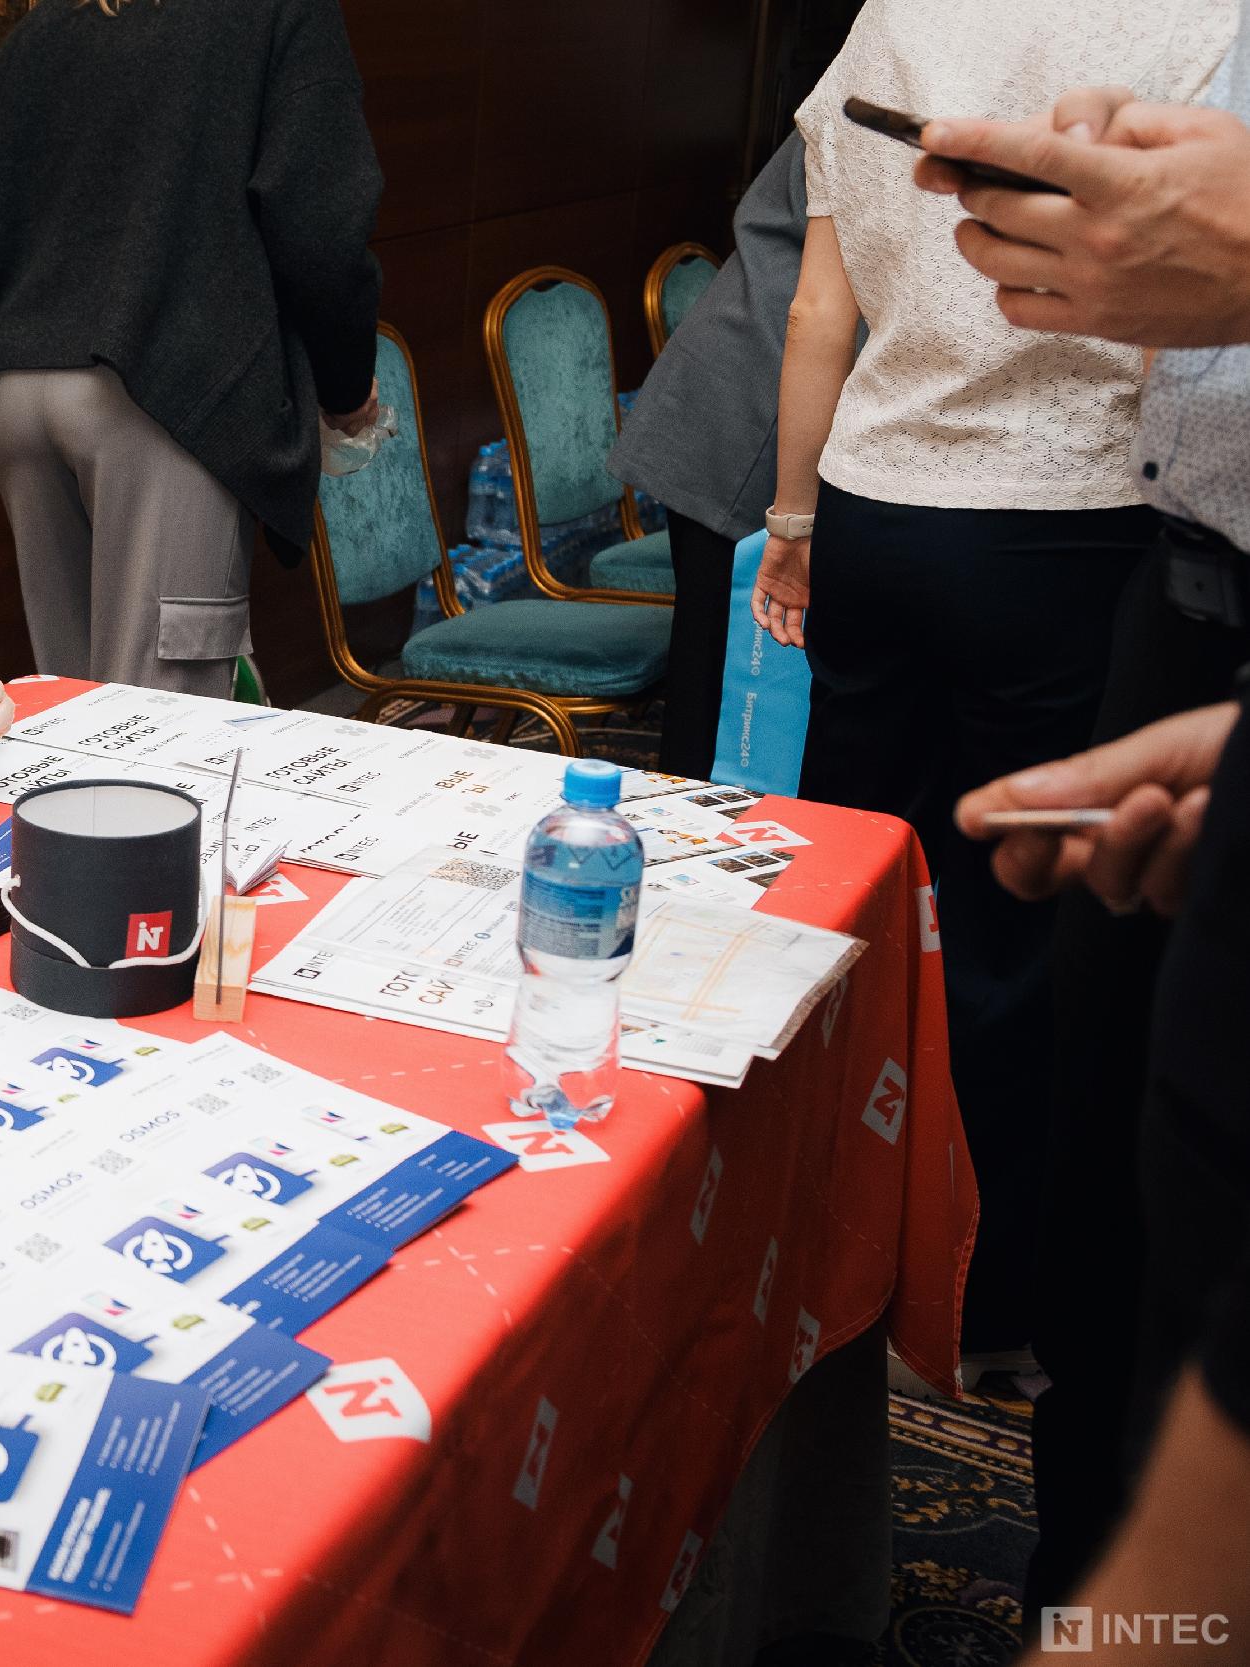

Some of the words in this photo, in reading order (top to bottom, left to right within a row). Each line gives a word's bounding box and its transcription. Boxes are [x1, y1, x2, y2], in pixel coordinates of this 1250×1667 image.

[78, 713, 151, 747] ГОТОВЫЕ
[102, 725, 161, 752] САЙТЫ
[264, 745, 341, 780] ГОТОВЫЕ
[292, 758, 354, 786] САЙТЫ
[306, 950, 334, 968] INTE
